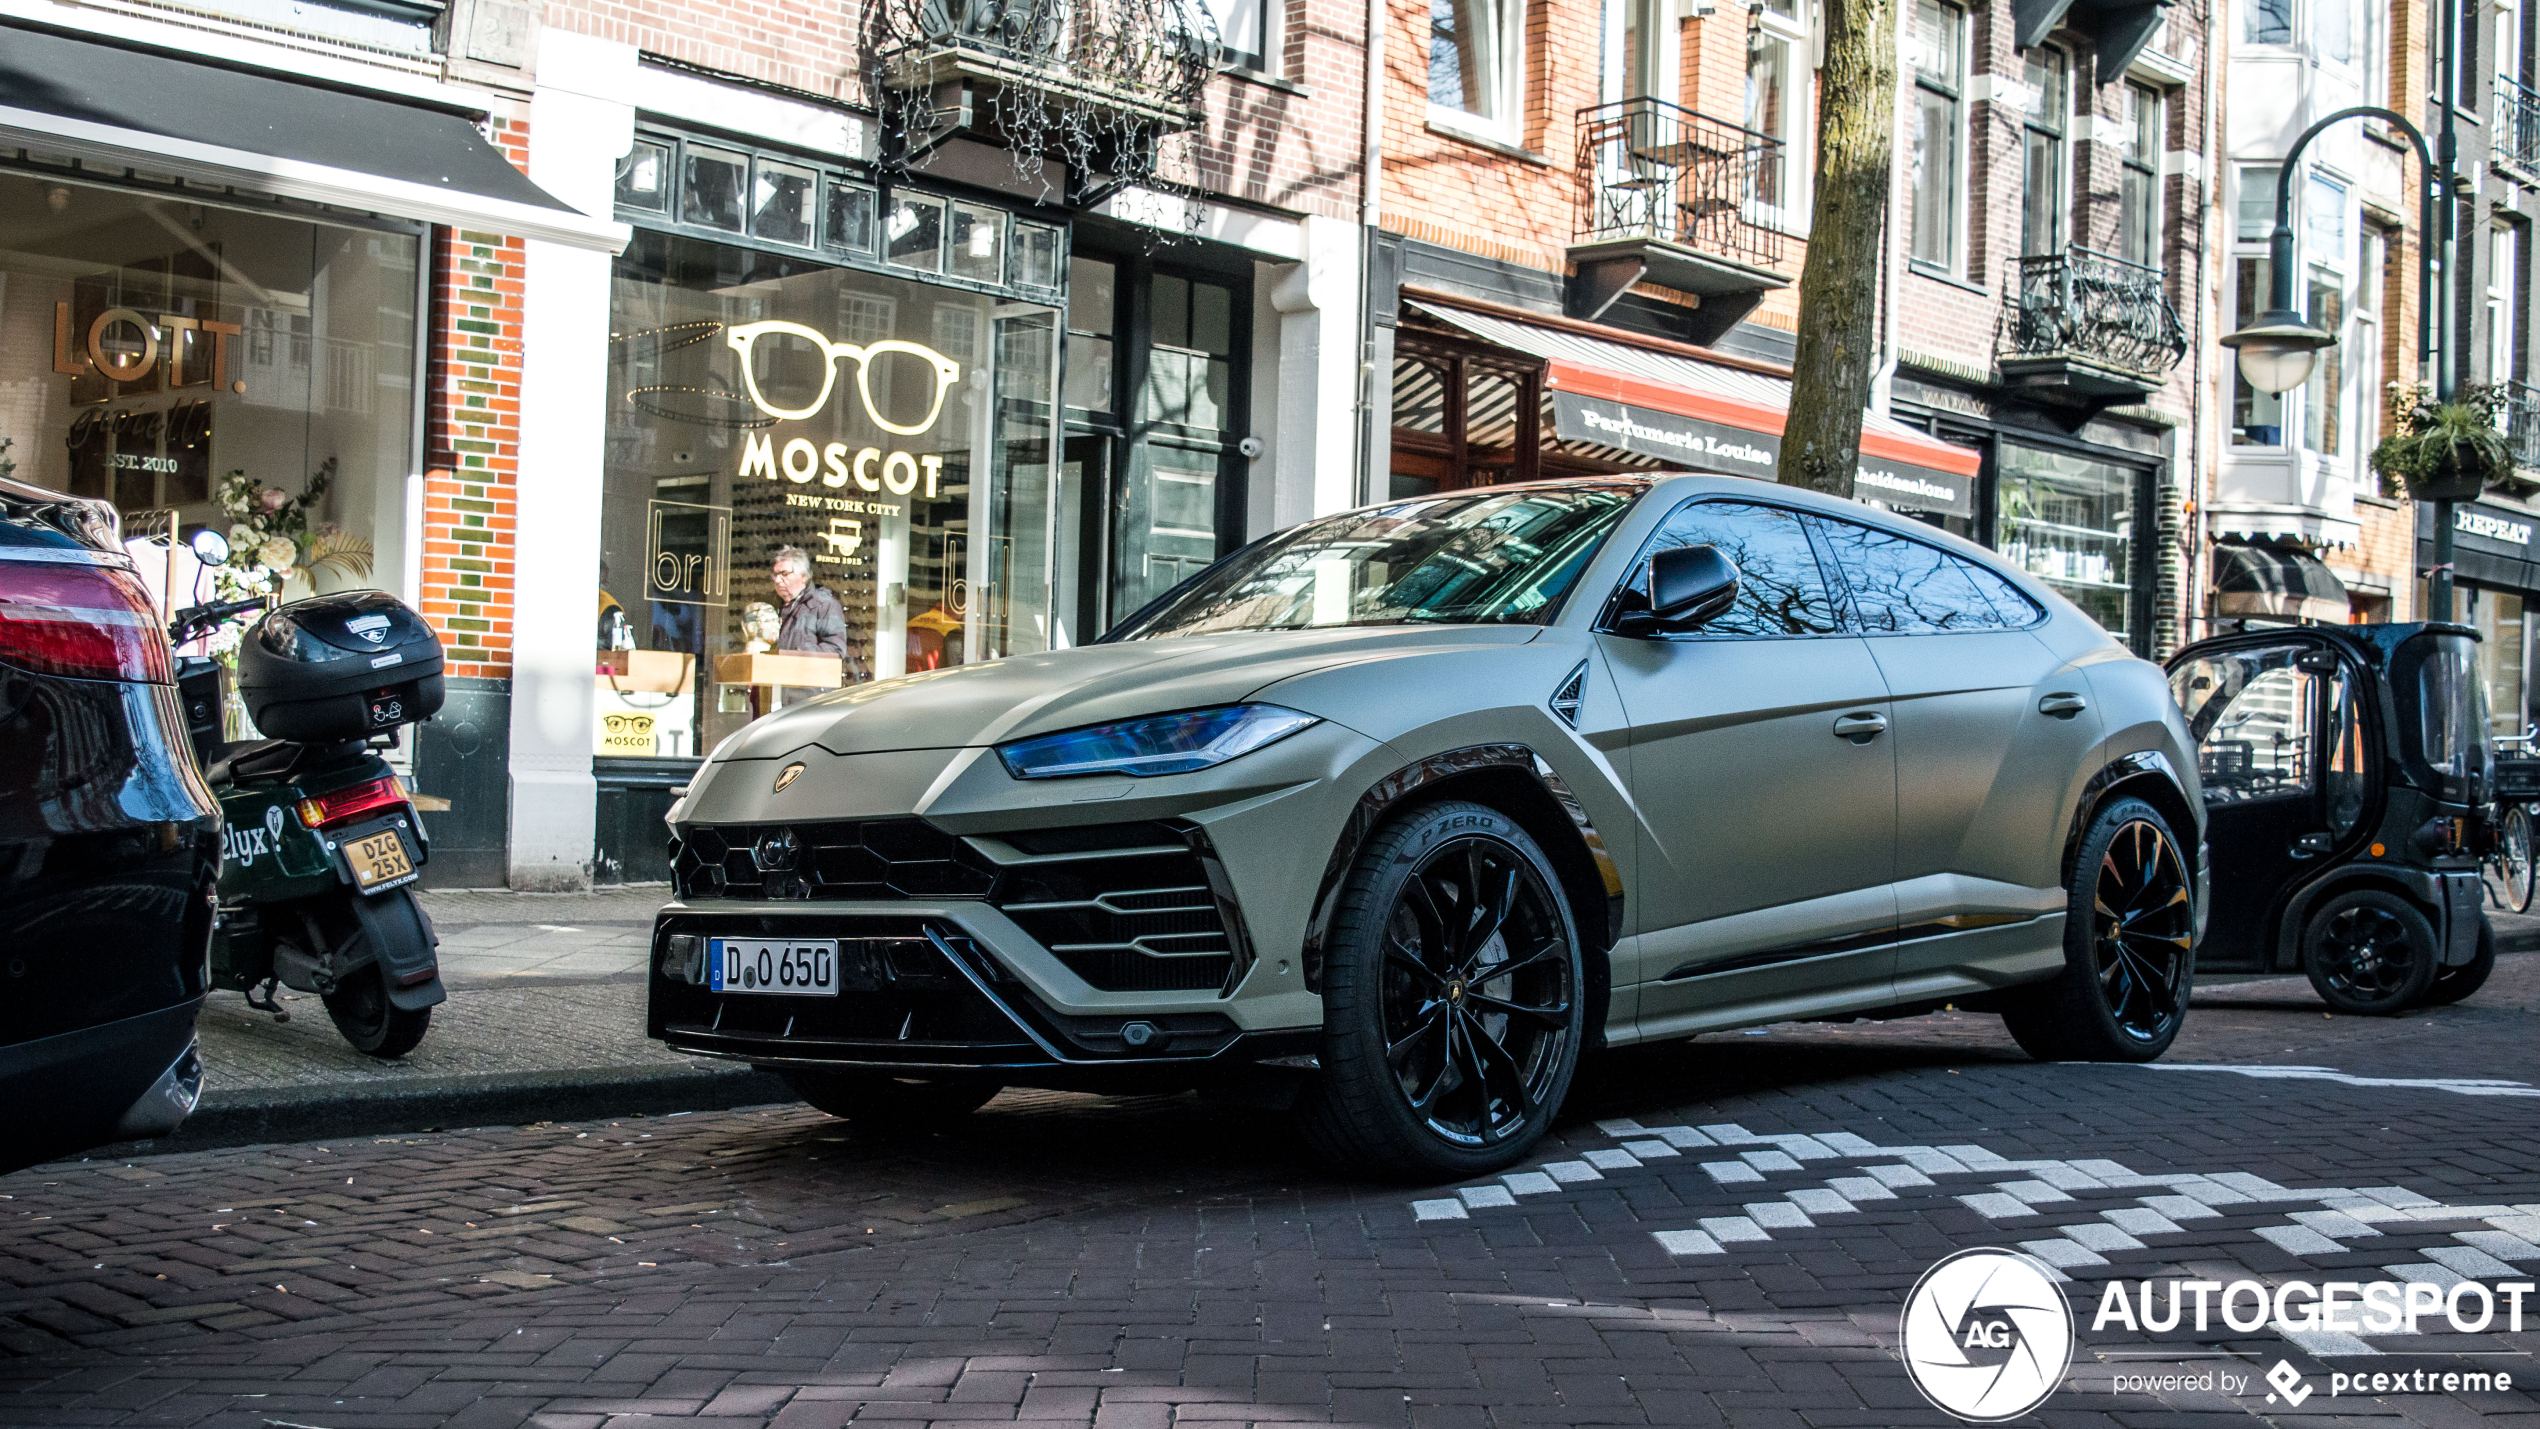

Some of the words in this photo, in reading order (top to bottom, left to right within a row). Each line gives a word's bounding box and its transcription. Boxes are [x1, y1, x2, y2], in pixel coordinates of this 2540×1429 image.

[54, 302, 246, 391] LOTT.
[1581, 409, 1703, 451] Parfumerie
[1704, 436, 1773, 465] Louise
[142, 456, 178, 473] 2010
[738, 431, 943, 498] MOSCOT
[786, 494, 823, 508] NEW
[824, 498, 865, 513] YORK
[867, 503, 901, 516] CITY
[2454, 510, 2532, 545] REPEAT
[604, 736, 650, 747] MOSCOT
[1438, 815, 1493, 835] ZERO
[362, 835, 398, 860] DZG
[372, 854, 408, 879] 25X
[363, 873, 419, 896] WWW.FELYX.COM
[726, 946, 741, 985] D
[779, 947, 831, 987] 650
